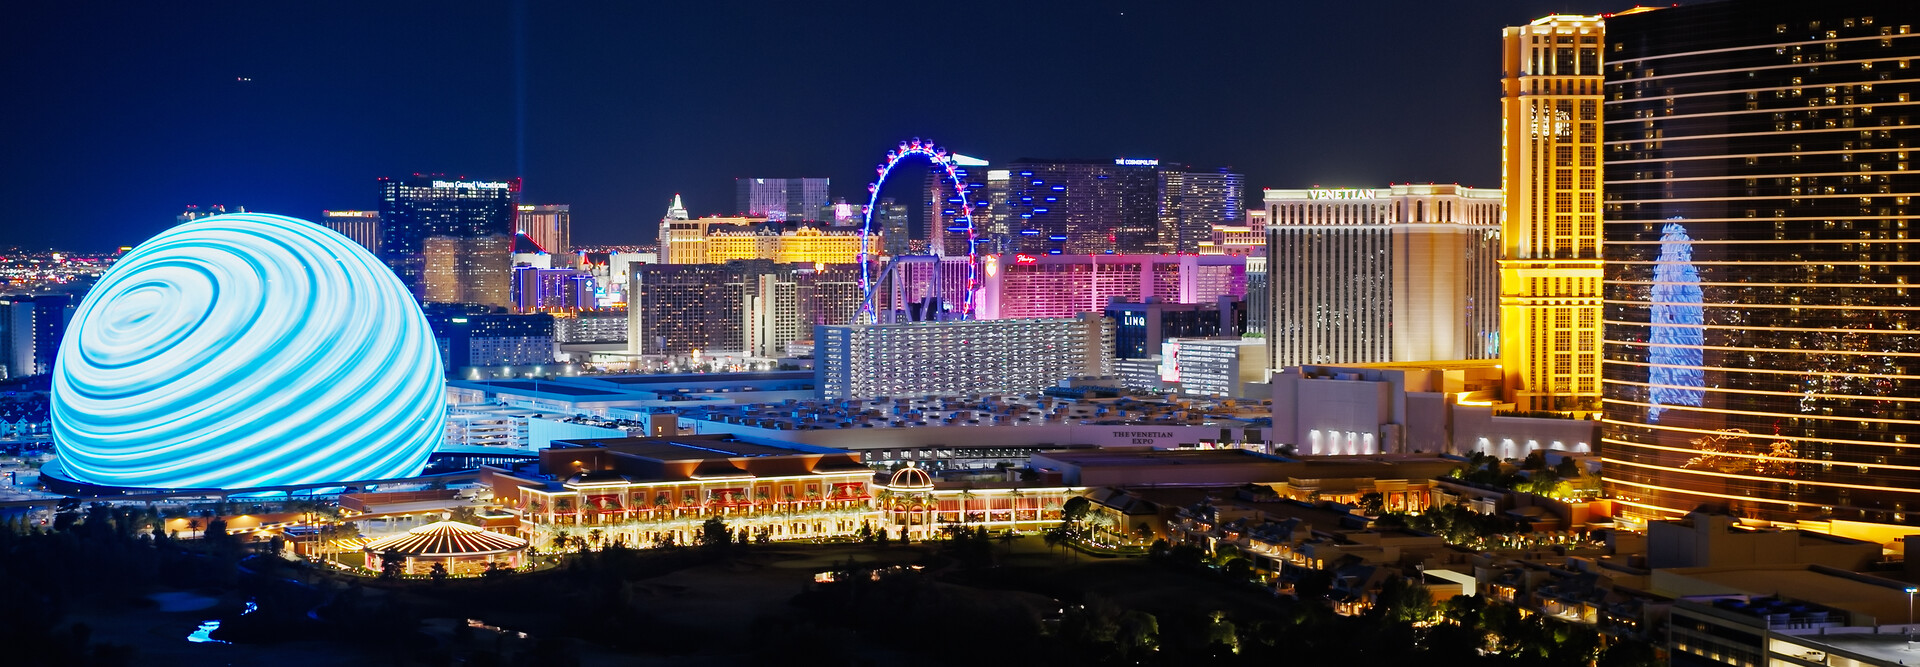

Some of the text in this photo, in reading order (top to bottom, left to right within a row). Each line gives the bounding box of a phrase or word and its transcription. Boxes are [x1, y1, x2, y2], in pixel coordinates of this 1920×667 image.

[432, 180, 509, 189] Hilton Grand Vacations
[1308, 188, 1377, 200] VENETIAN
[1124, 316, 1145, 326] LINQ
